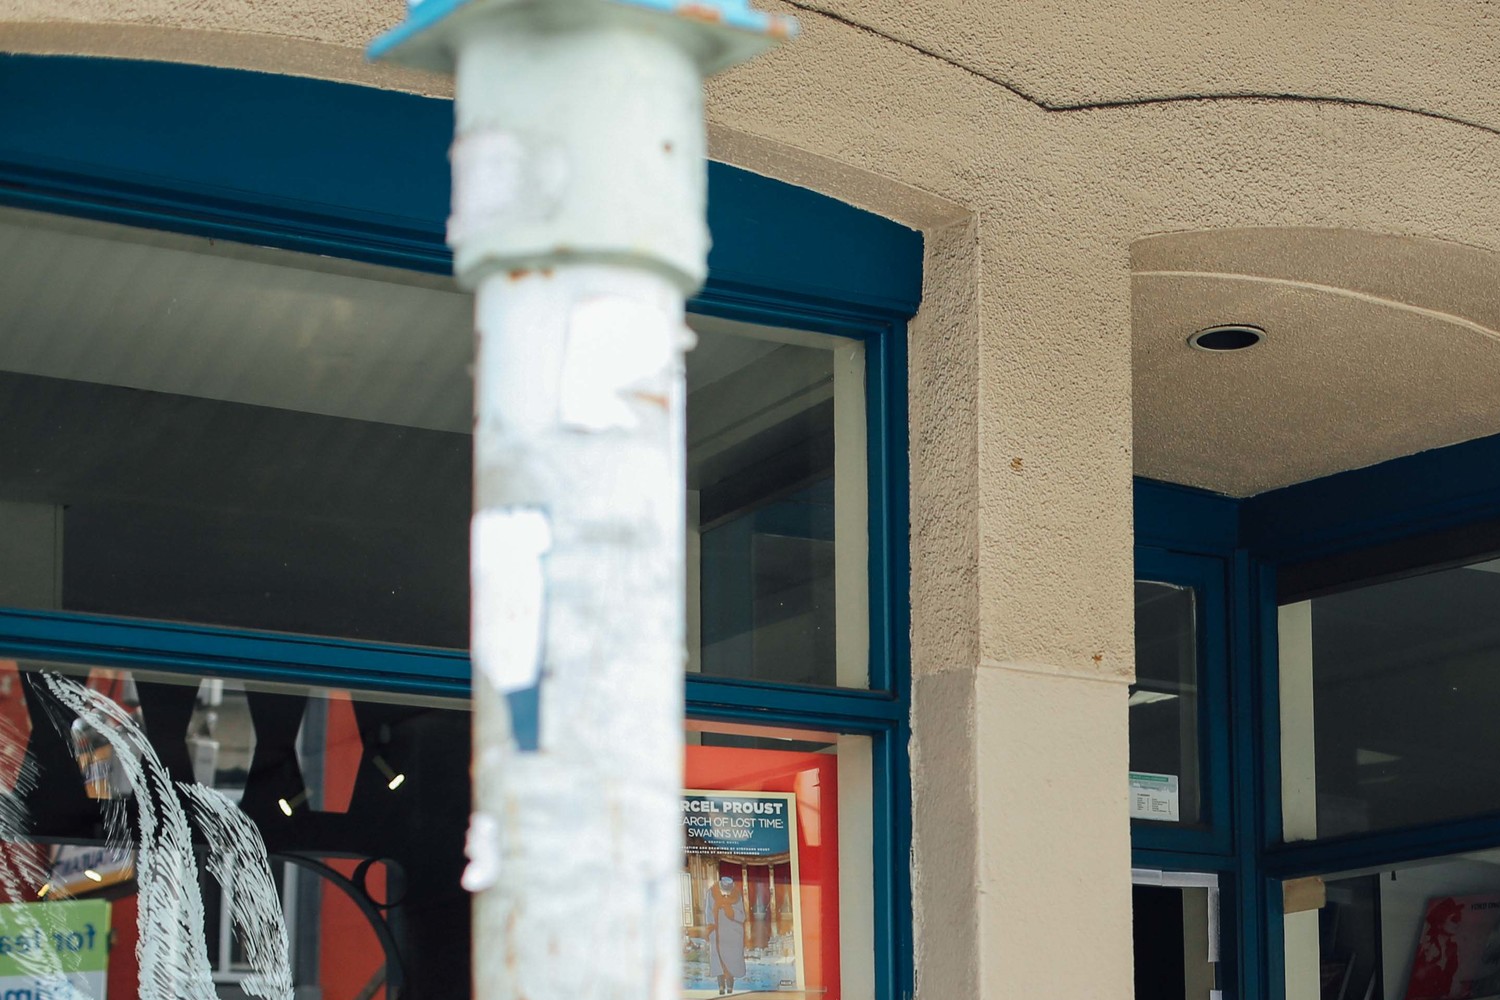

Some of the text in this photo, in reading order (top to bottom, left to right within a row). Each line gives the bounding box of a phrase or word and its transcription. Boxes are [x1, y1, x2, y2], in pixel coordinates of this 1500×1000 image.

[681, 800, 783, 814] RCEL PROUST
[682, 816, 712, 827] ARCH
[713, 817, 729, 827] OF
[730, 818, 757, 828] LOST
[688, 828, 754, 839] SWANN'S WAY
